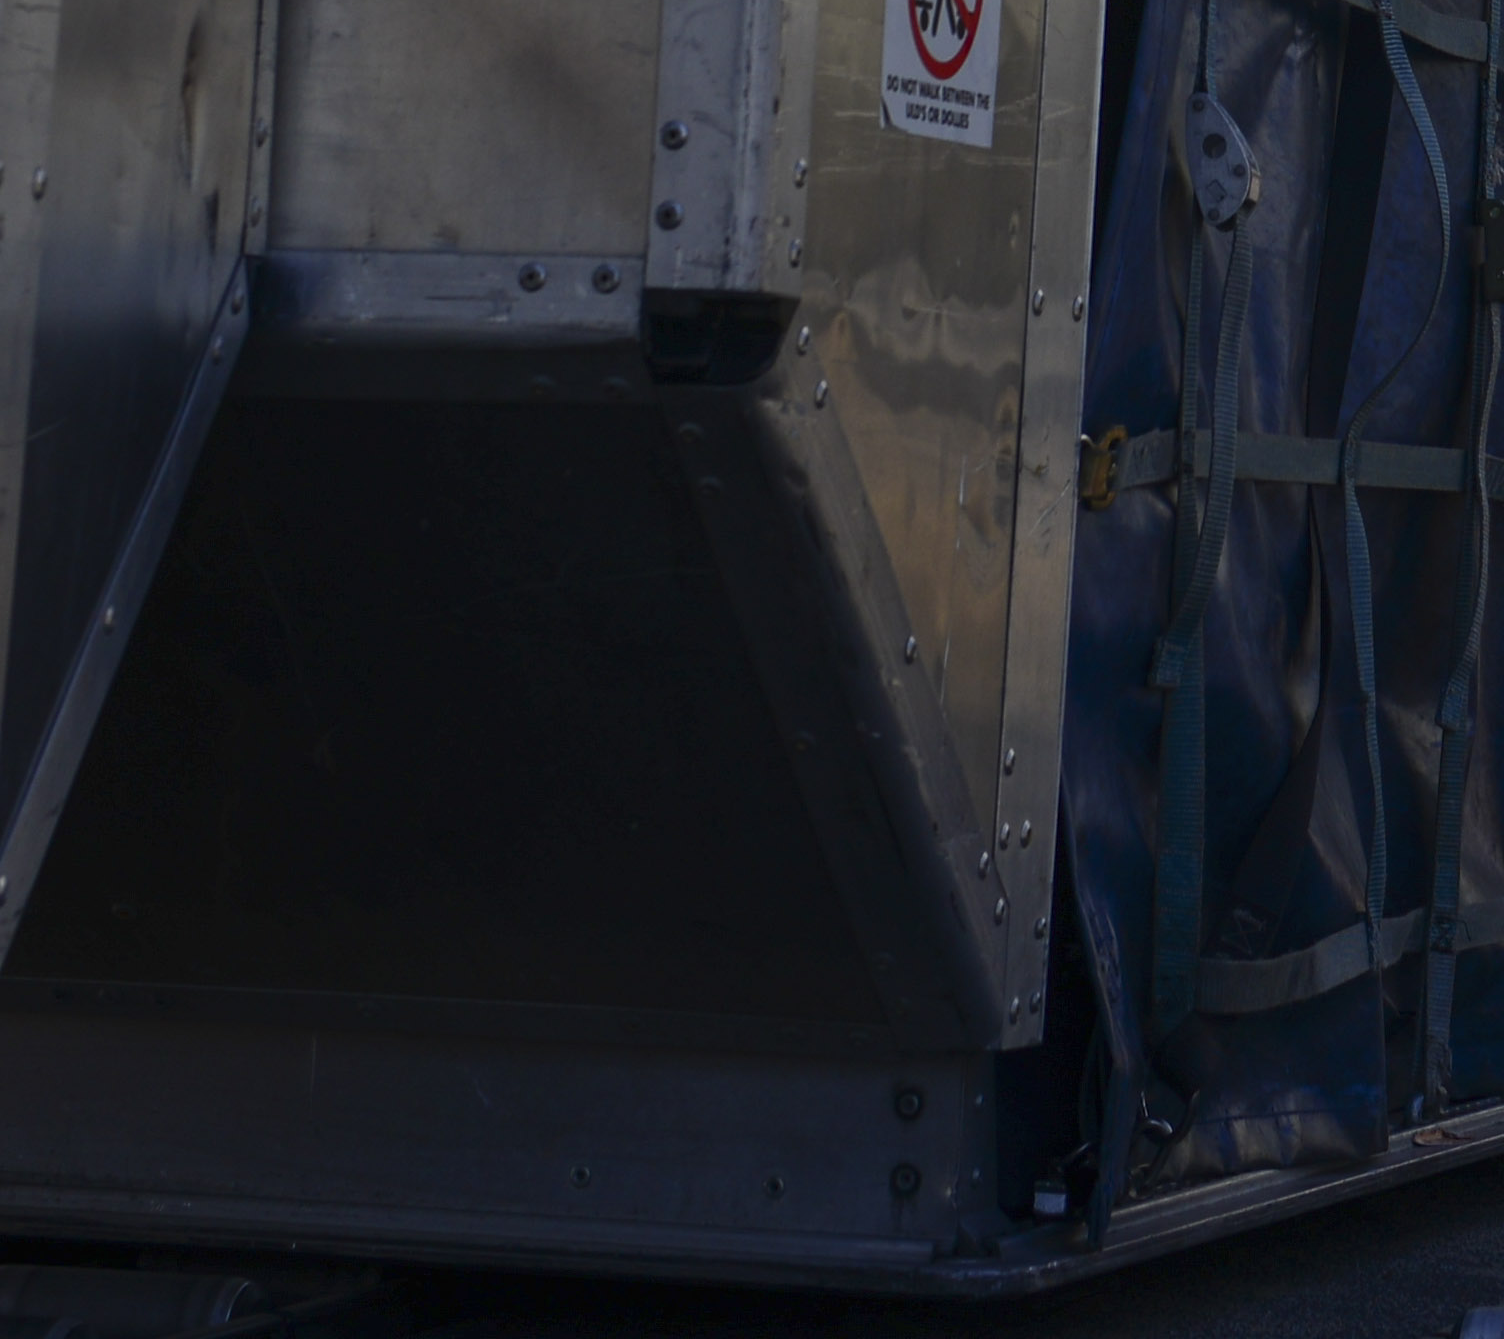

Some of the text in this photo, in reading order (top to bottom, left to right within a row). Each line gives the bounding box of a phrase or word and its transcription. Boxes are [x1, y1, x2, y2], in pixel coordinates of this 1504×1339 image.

[886, 73, 991, 111] DO NOT WALK BETWEEN THE
[927, 105, 940, 124] OR
